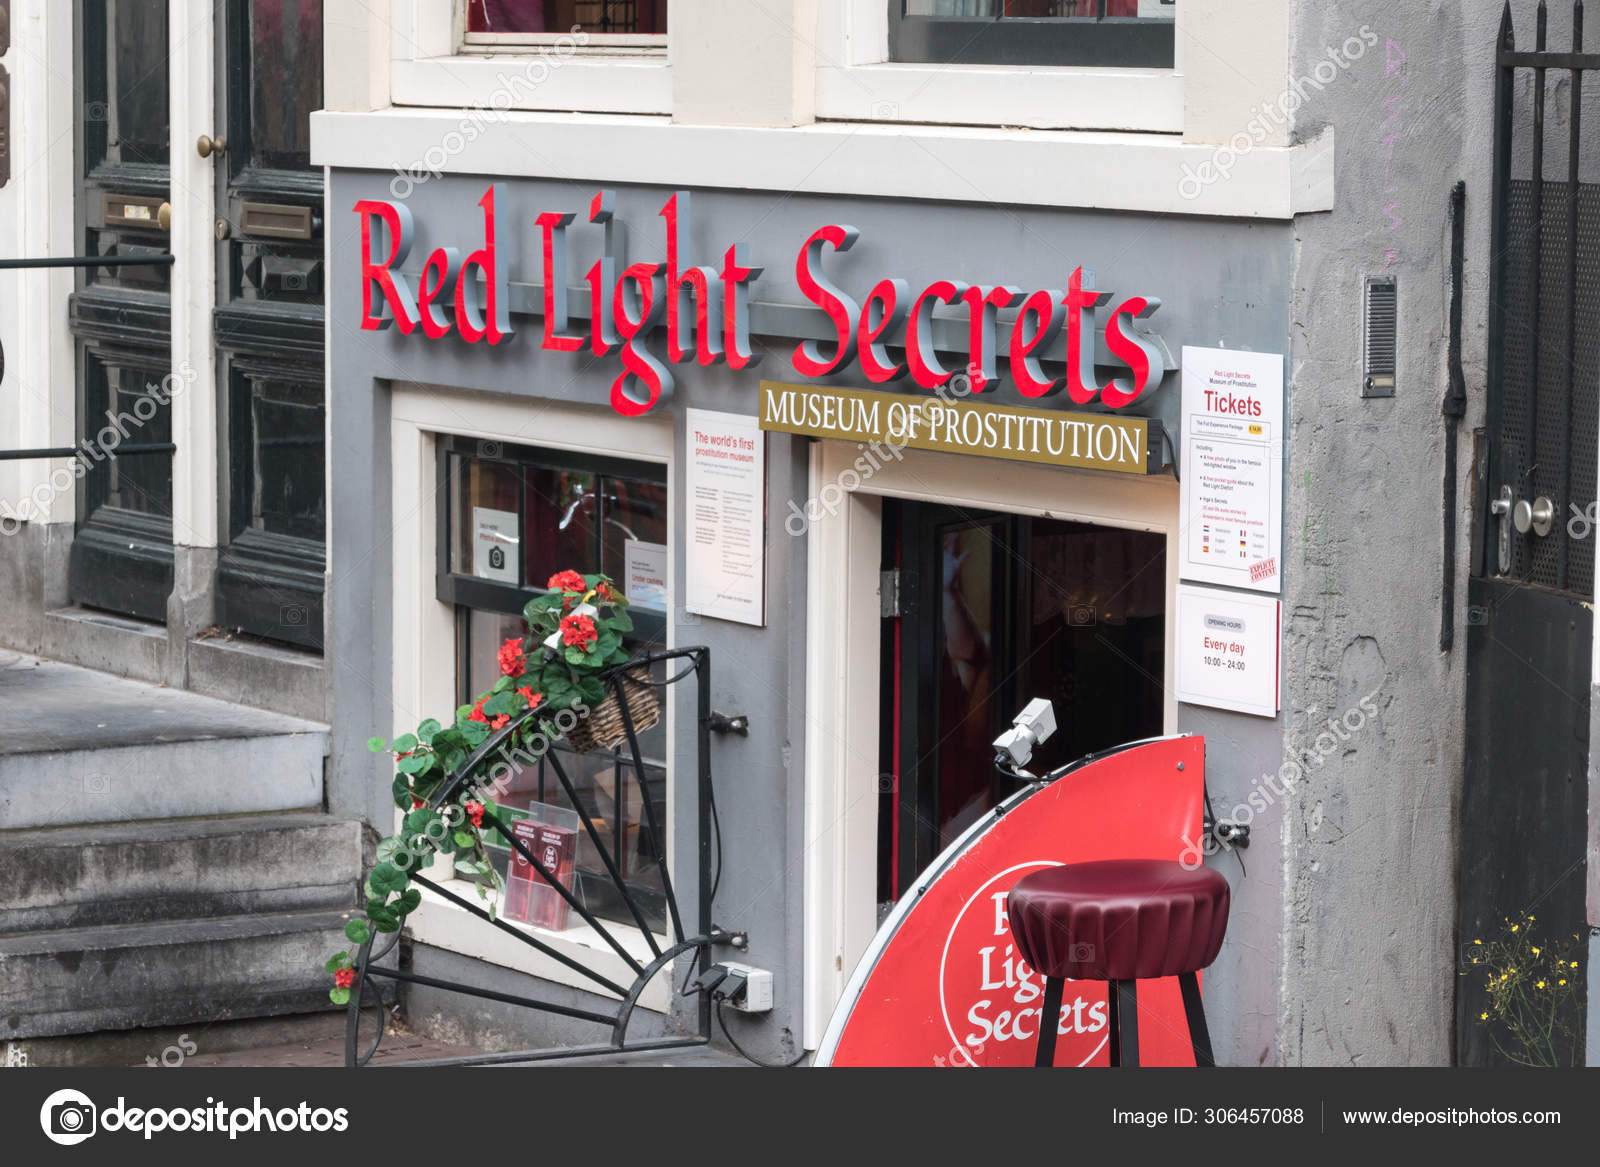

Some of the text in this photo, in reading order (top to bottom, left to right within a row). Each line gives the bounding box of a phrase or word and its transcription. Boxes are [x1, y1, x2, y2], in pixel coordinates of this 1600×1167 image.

[353, 183, 1158, 417] Red Light Secrets
[1203, 389, 1262, 417] Tickets
[765, 388, 1142, 465] MUSEUM OF PROSTITUTION
[694, 431, 754, 451] The world's first
[1203, 636, 1245, 657] Every day
[1203, 655, 1221, 668] 10:00
[1227, 659, 1246, 671] 24:00
[965, 996, 1107, 1046] Secets
